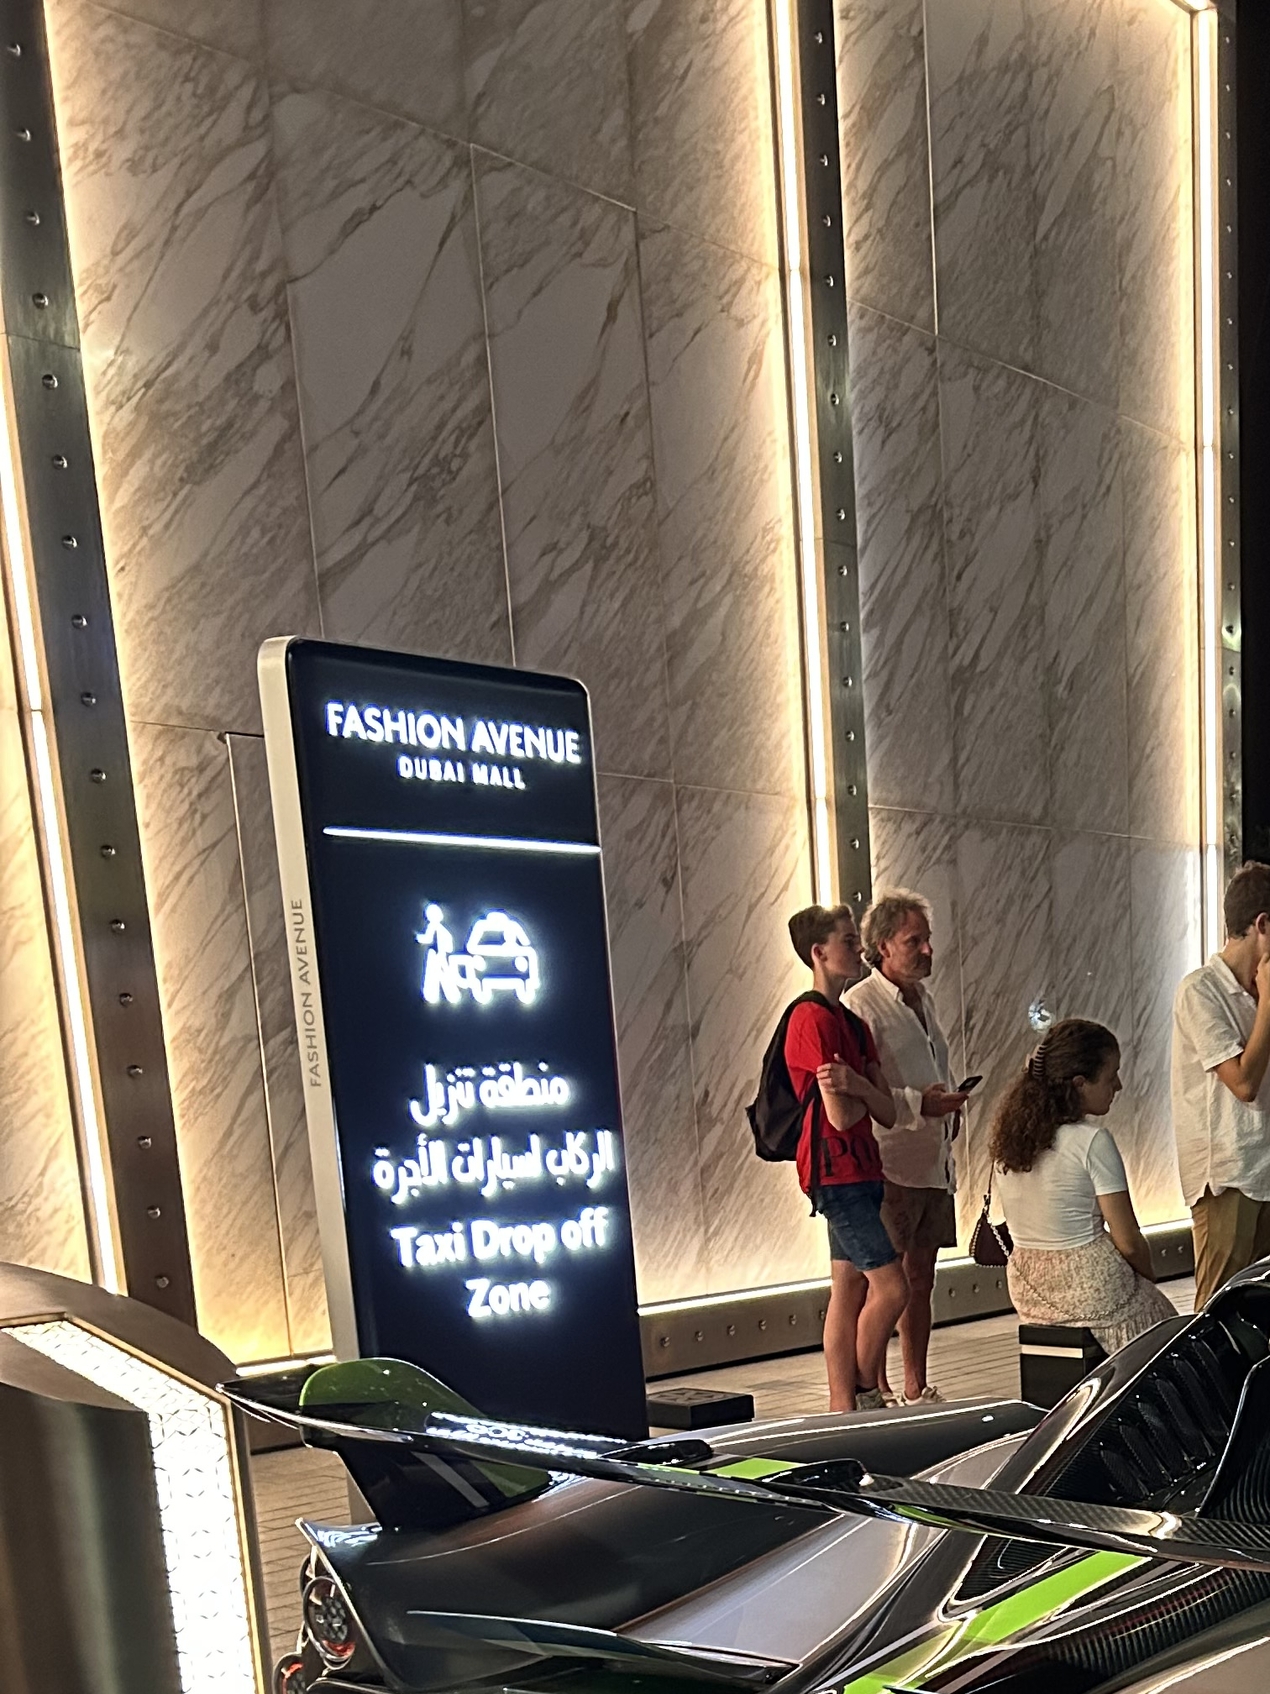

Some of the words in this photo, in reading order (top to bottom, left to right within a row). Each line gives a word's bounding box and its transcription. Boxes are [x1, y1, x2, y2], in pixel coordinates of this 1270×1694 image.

[326, 701, 466, 752] FASHION
[471, 718, 582, 765] AVENUE
[397, 755, 465, 784] DUBAI
[470, 761, 526, 791] MALL
[291, 898, 311, 986] AVENUE
[301, 992, 321, 1087] FASHION
[409, 1062, 476, 1127] تنزيل
[478, 1061, 571, 1108] منطقة
[373, 1132, 448, 1205] الأجرة
[452, 1132, 543, 1198] لسيارات
[545, 1129, 616, 1189] الركاب
[390, 1221, 466, 1268] Taxi
[470, 1219, 556, 1264] Drop
[561, 1206, 609, 1250] off
[465, 1277, 551, 1318] Zone
